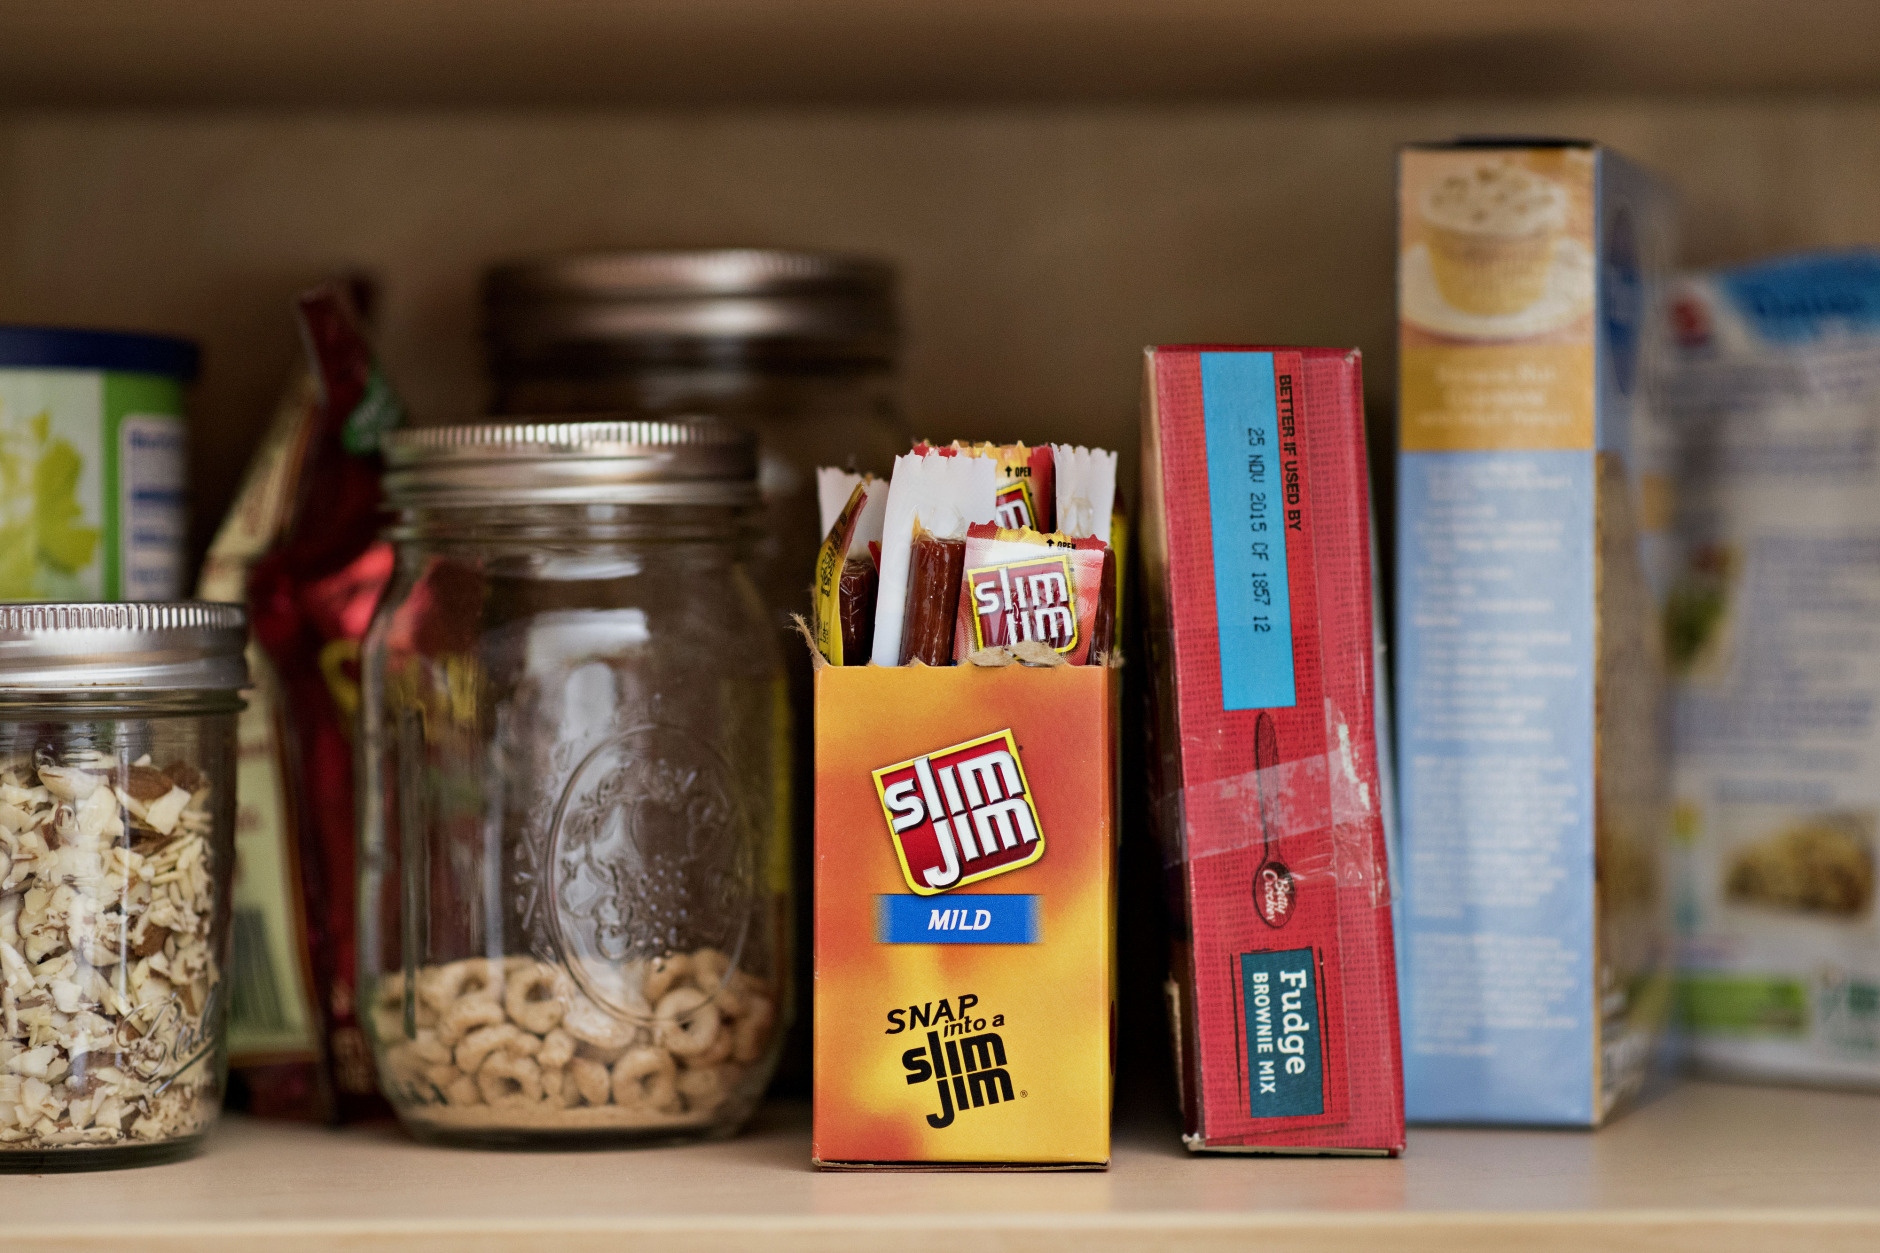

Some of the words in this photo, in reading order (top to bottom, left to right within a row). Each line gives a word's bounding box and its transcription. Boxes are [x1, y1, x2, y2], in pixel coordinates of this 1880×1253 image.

[1279, 374, 1296, 438] BETTER
[1248, 427, 1266, 446] 25
[1283, 442, 1297, 456] IF
[1015, 466, 1032, 478] OPEN
[1248, 454, 1266, 483] NOV
[1284, 461, 1300, 505] USED
[1250, 492, 1267, 532] 2015
[1288, 509, 1301, 531] BY
[1057, 541, 1077, 552] OPEN
[1251, 542, 1270, 561] CF
[1252, 572, 1271, 606] 1857
[1253, 616, 1271, 633] 12
[1262, 869, 1278, 921] Crocker
[1275, 877, 1290, 915] Betty
[927, 908, 992, 931] MILD
[885, 993, 979, 1035] SNAP
[943, 1015, 987, 1038] into
[992, 1014, 1006, 1028] a
[1252, 971, 1274, 1054] BROWNIE
[1277, 969, 1310, 1074] Fudge
[1258, 1060, 1276, 1094] MIX
